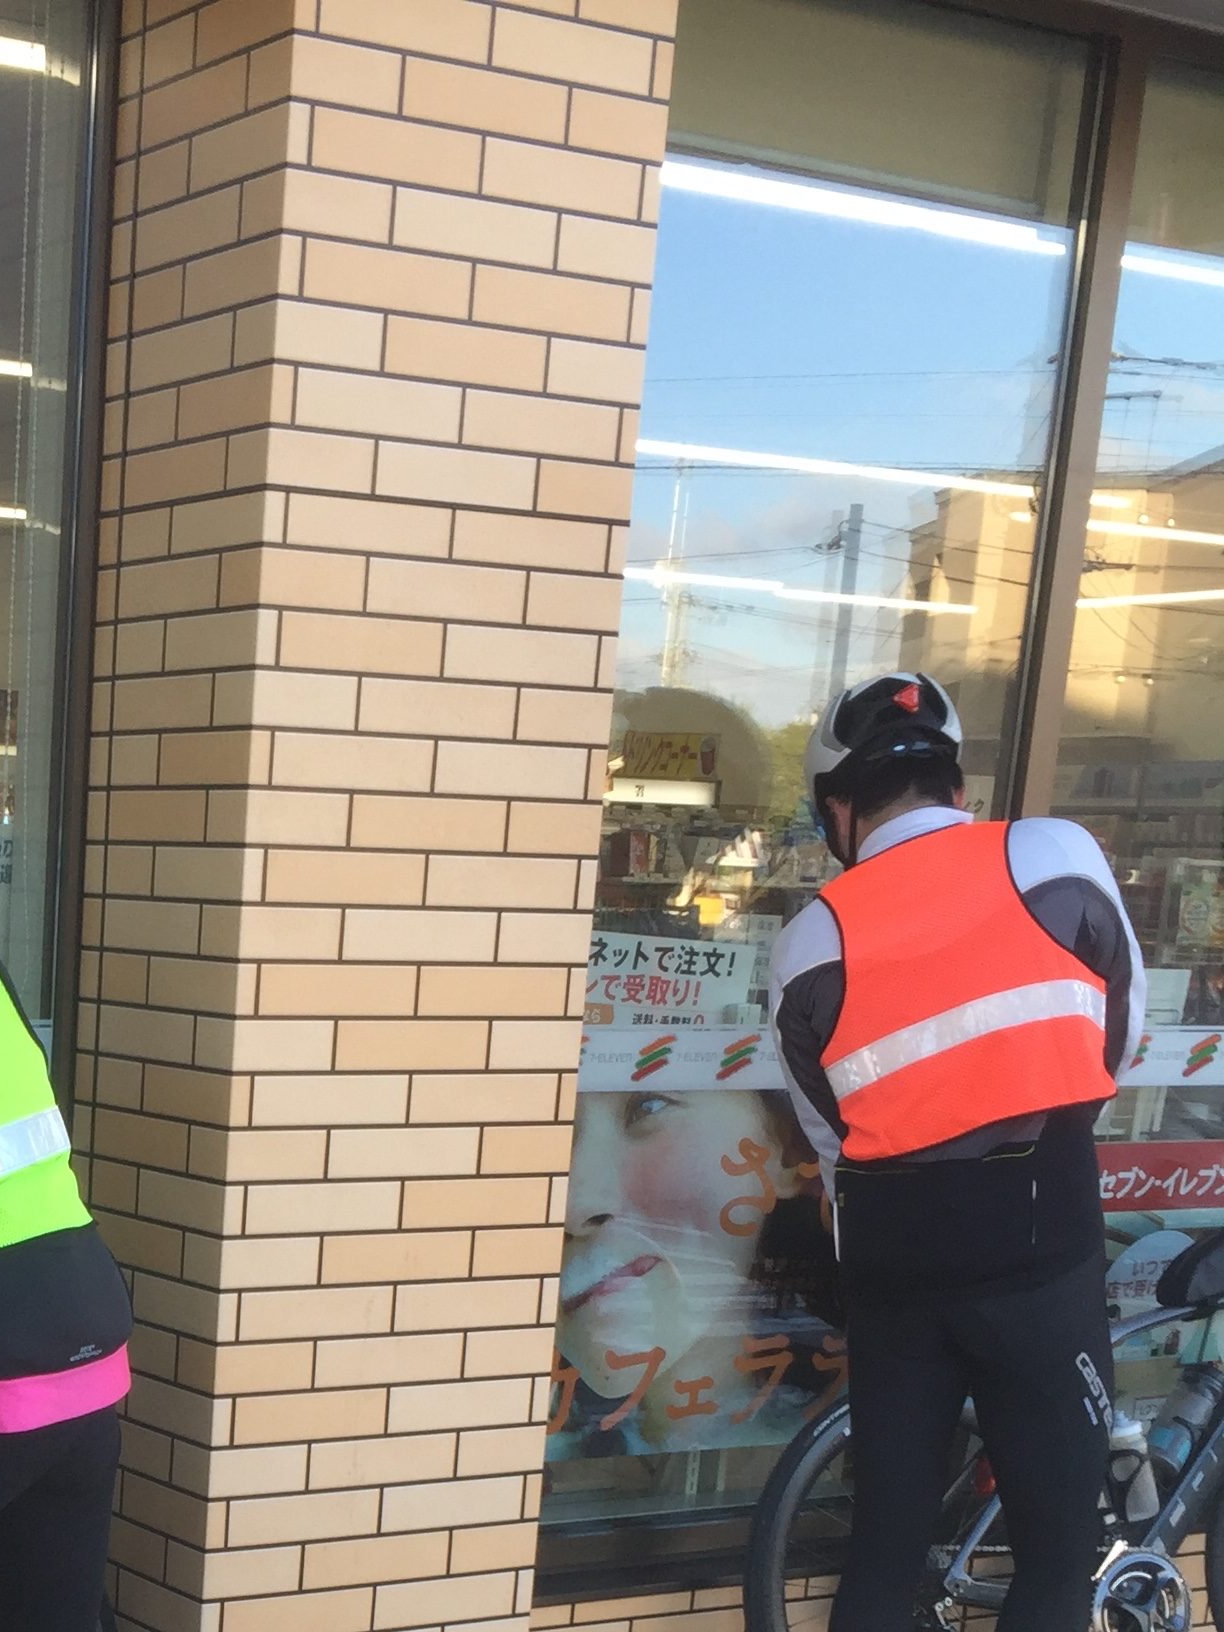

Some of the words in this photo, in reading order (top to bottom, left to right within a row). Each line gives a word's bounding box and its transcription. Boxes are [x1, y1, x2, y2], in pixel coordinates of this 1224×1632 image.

[589, 938, 736, 978] ネットで注文!
